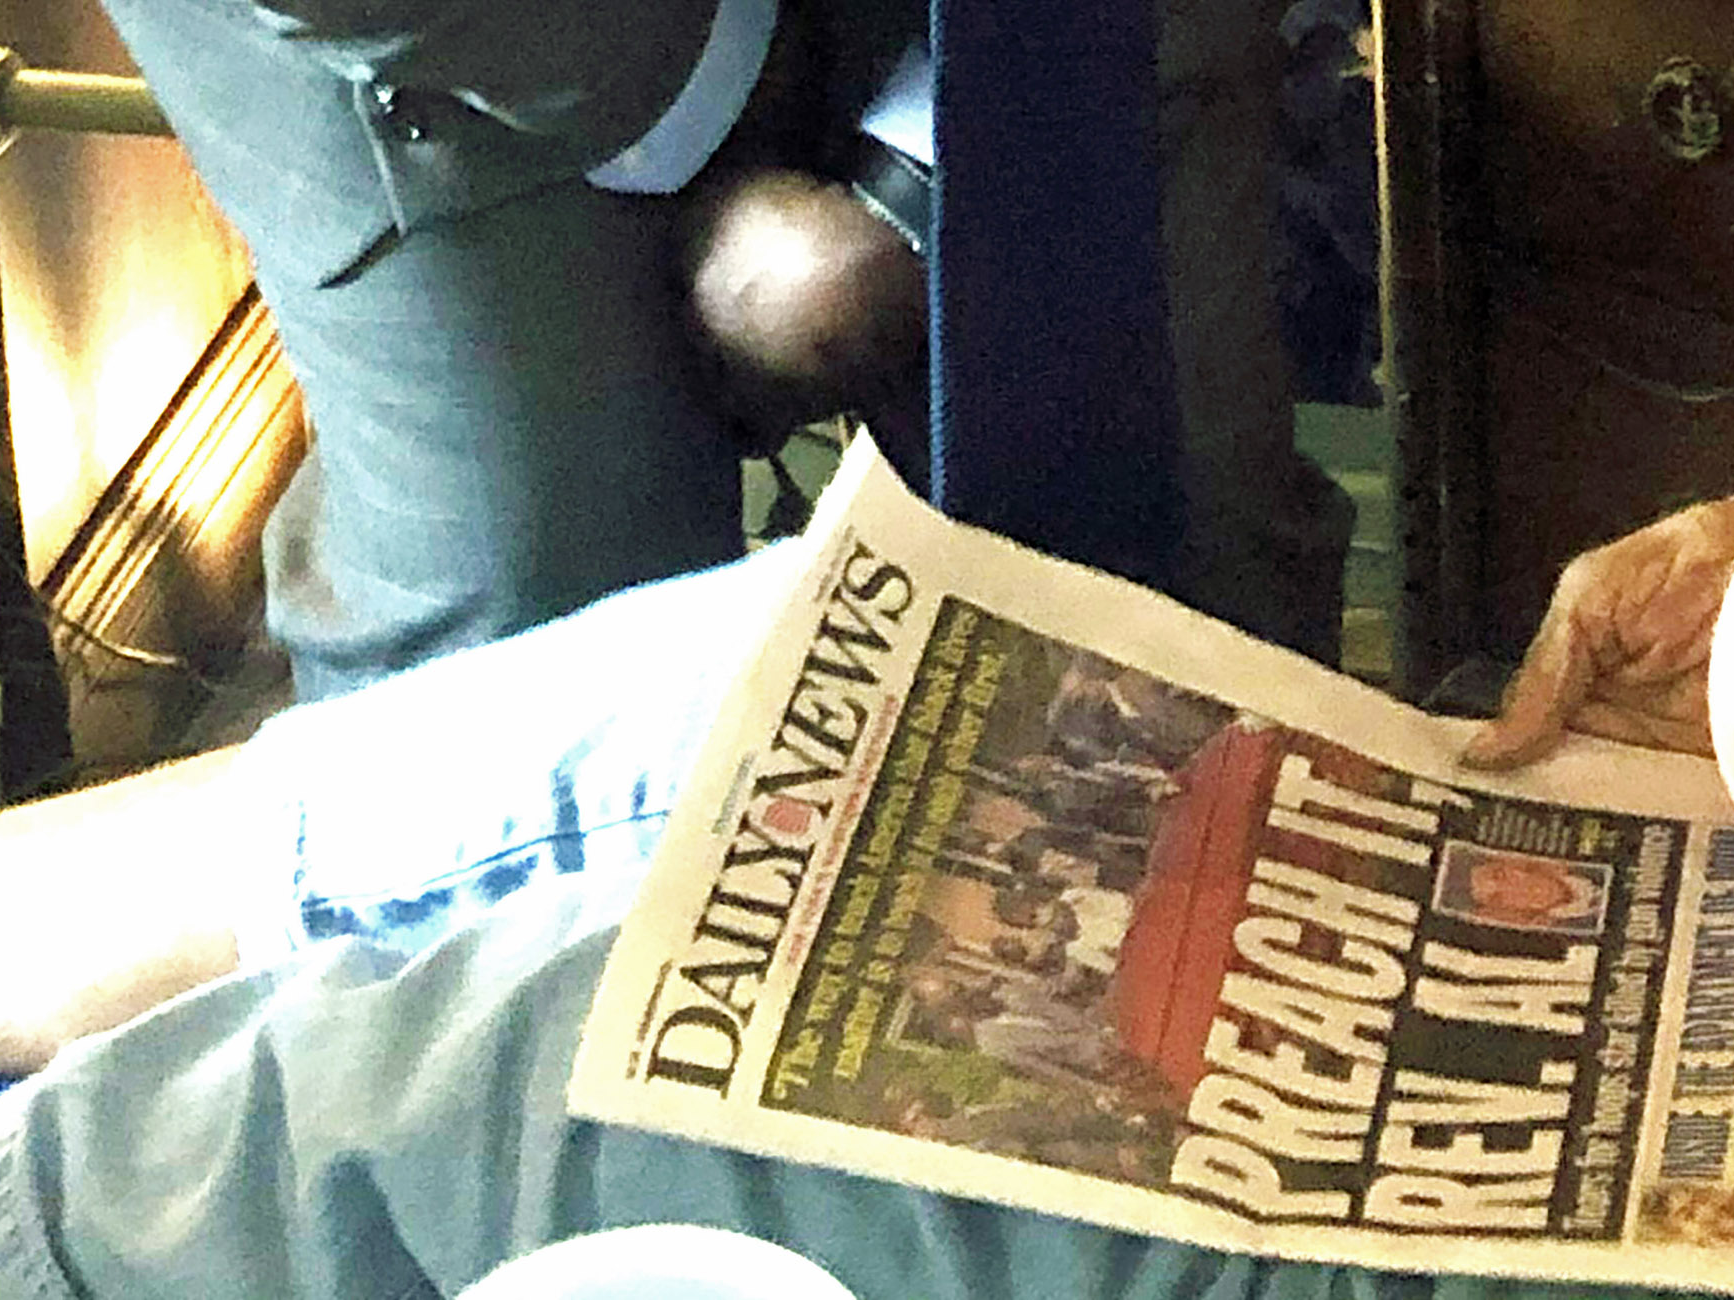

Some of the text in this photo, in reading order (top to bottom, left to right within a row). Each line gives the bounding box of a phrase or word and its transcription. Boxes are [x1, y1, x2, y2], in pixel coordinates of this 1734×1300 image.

[908, 665, 959, 734] black
[645, 810, 815, 1099] DAILY
[753, 541, 919, 817] NEWS
[1624, 824, 1672, 901] violence
[1625, 903, 1666, 941] gun
[1170, 754, 1473, 1218] PREACH IT,
[1414, 940, 1601, 1035] AL
[1610, 947, 1666, 970] by
[1600, 973, 1650, 1028] killed
[1596, 1029, 1640, 1070] star
[1580, 1072, 1641, 1136] hoops
[1365, 1061, 1578, 1230] REV.
[1660, 1109, 1733, 1179] INSIDE
